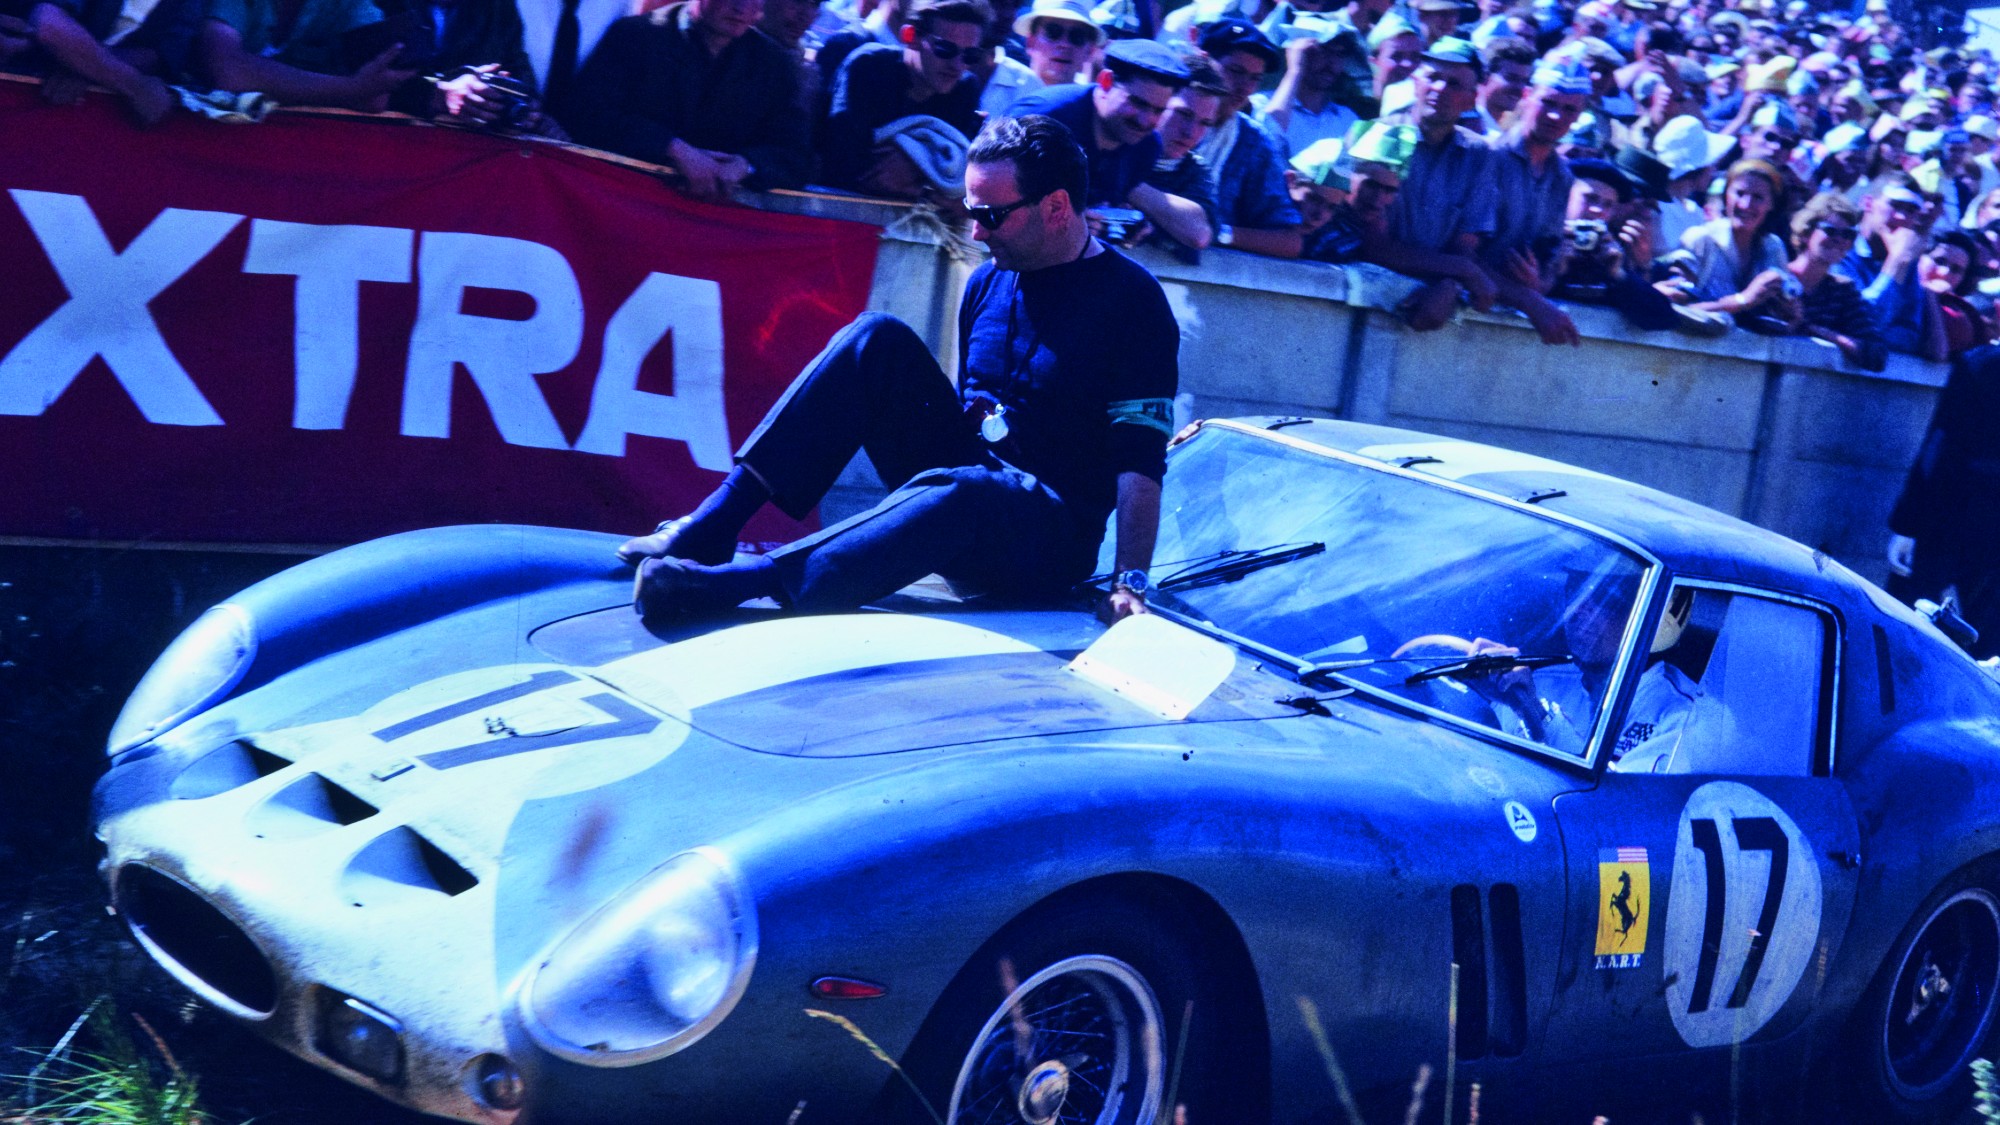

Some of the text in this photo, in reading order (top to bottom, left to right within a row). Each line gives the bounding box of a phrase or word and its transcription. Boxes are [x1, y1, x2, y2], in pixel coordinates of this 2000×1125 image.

[0, 188, 735, 473] XTRA
[370, 669, 664, 771] 17
[1687, 816, 1790, 1015] 17
